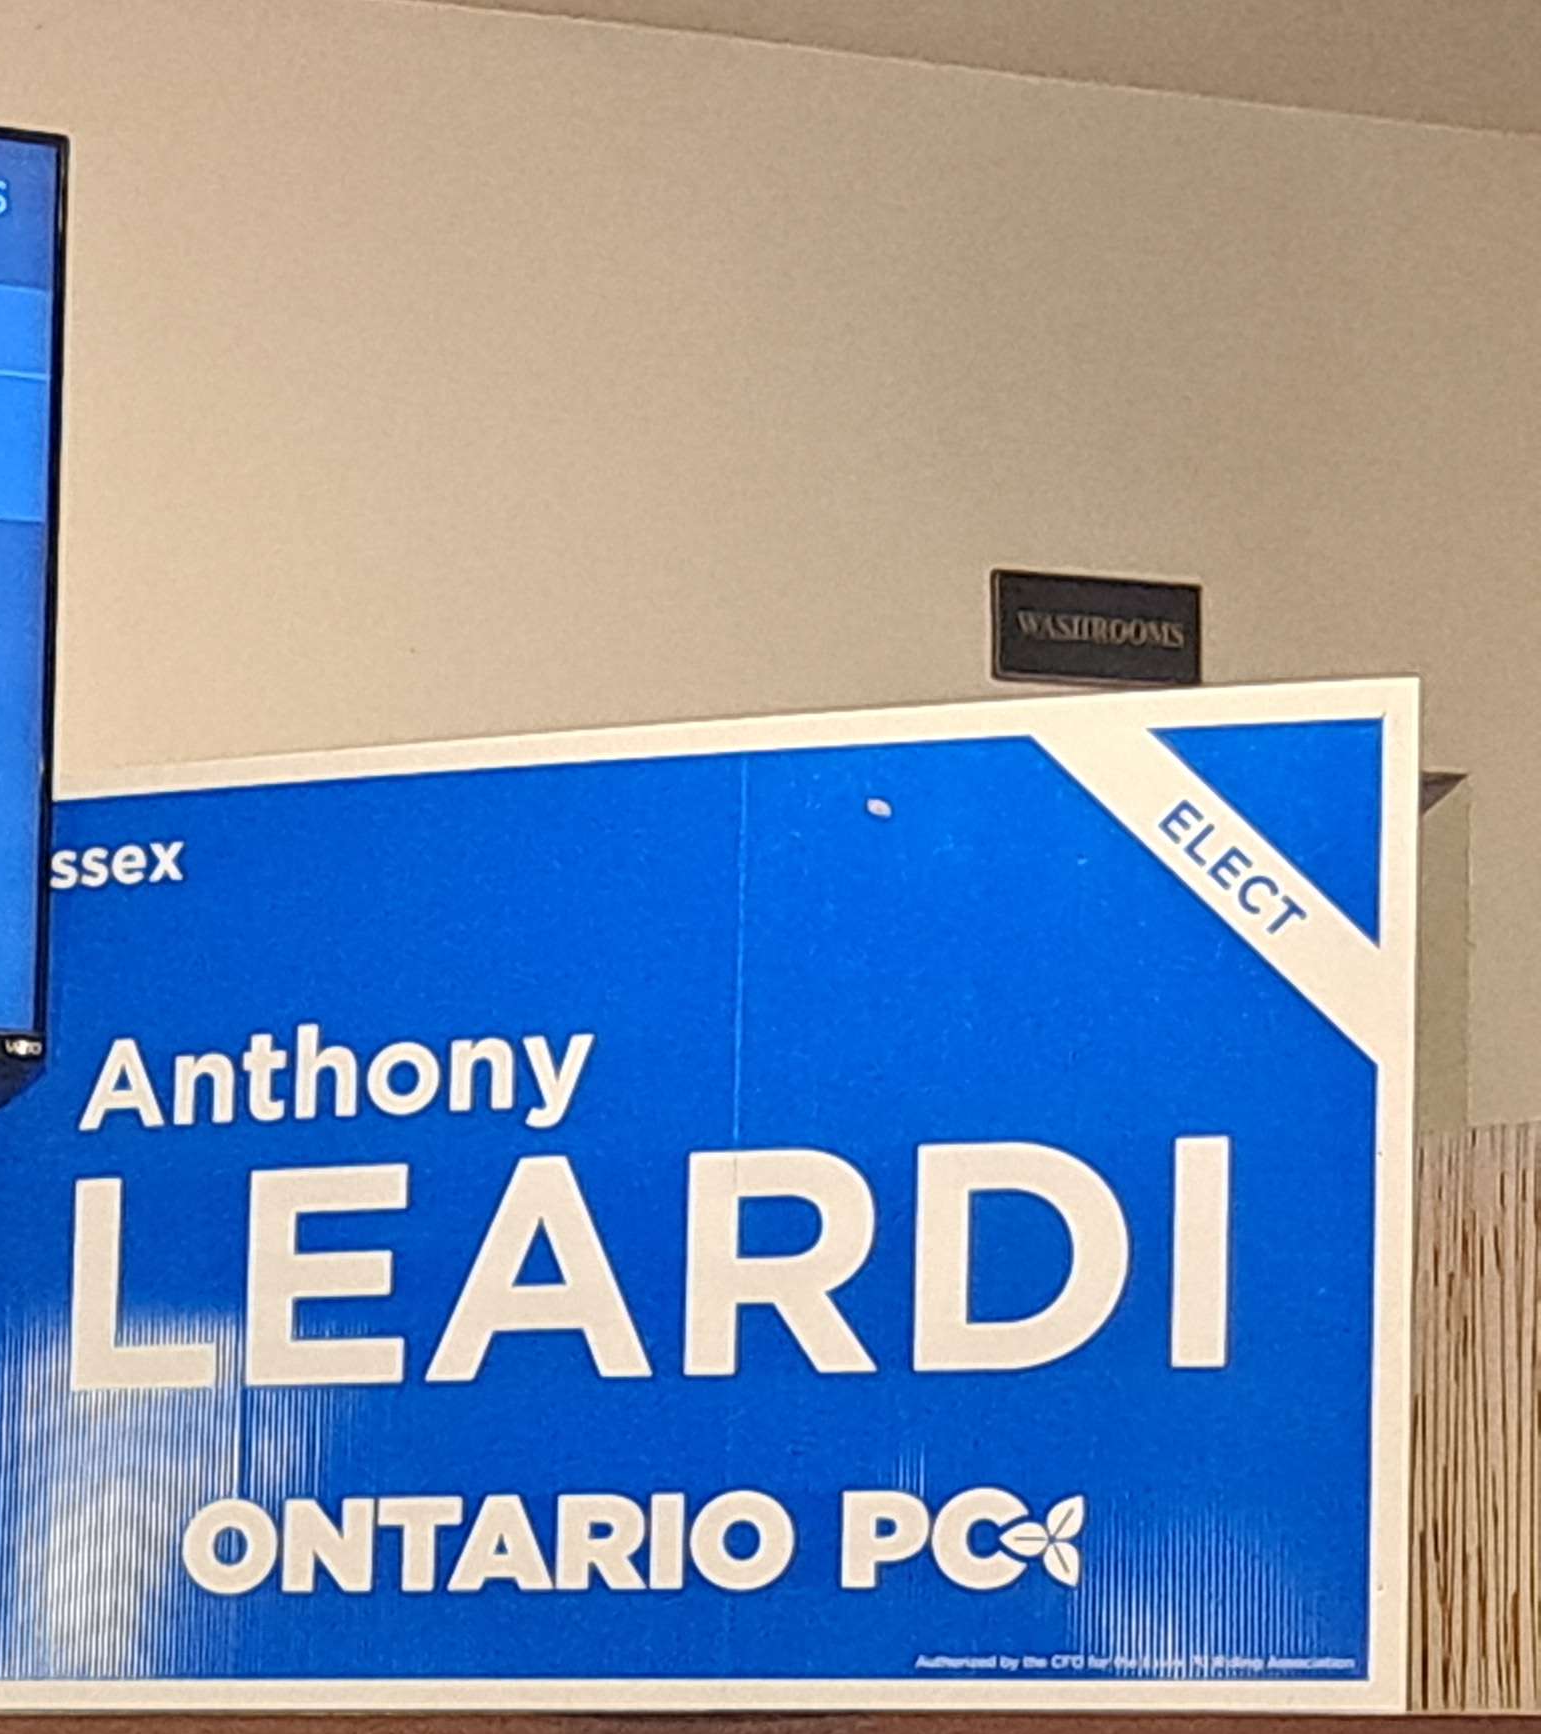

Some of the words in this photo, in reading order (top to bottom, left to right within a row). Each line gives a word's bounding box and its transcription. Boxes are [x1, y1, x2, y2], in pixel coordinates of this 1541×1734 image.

[1017, 609, 1184, 648] WASHROOMS
[49, 841, 184, 889] ssex
[1158, 800, 1307, 934] ELECT
[77, 1024, 595, 1133] Anthony
[68, 1134, 1231, 1393] LEARDI
[182, 1490, 794, 1595] ONTARIO
[841, 1487, 1027, 1591] PC
